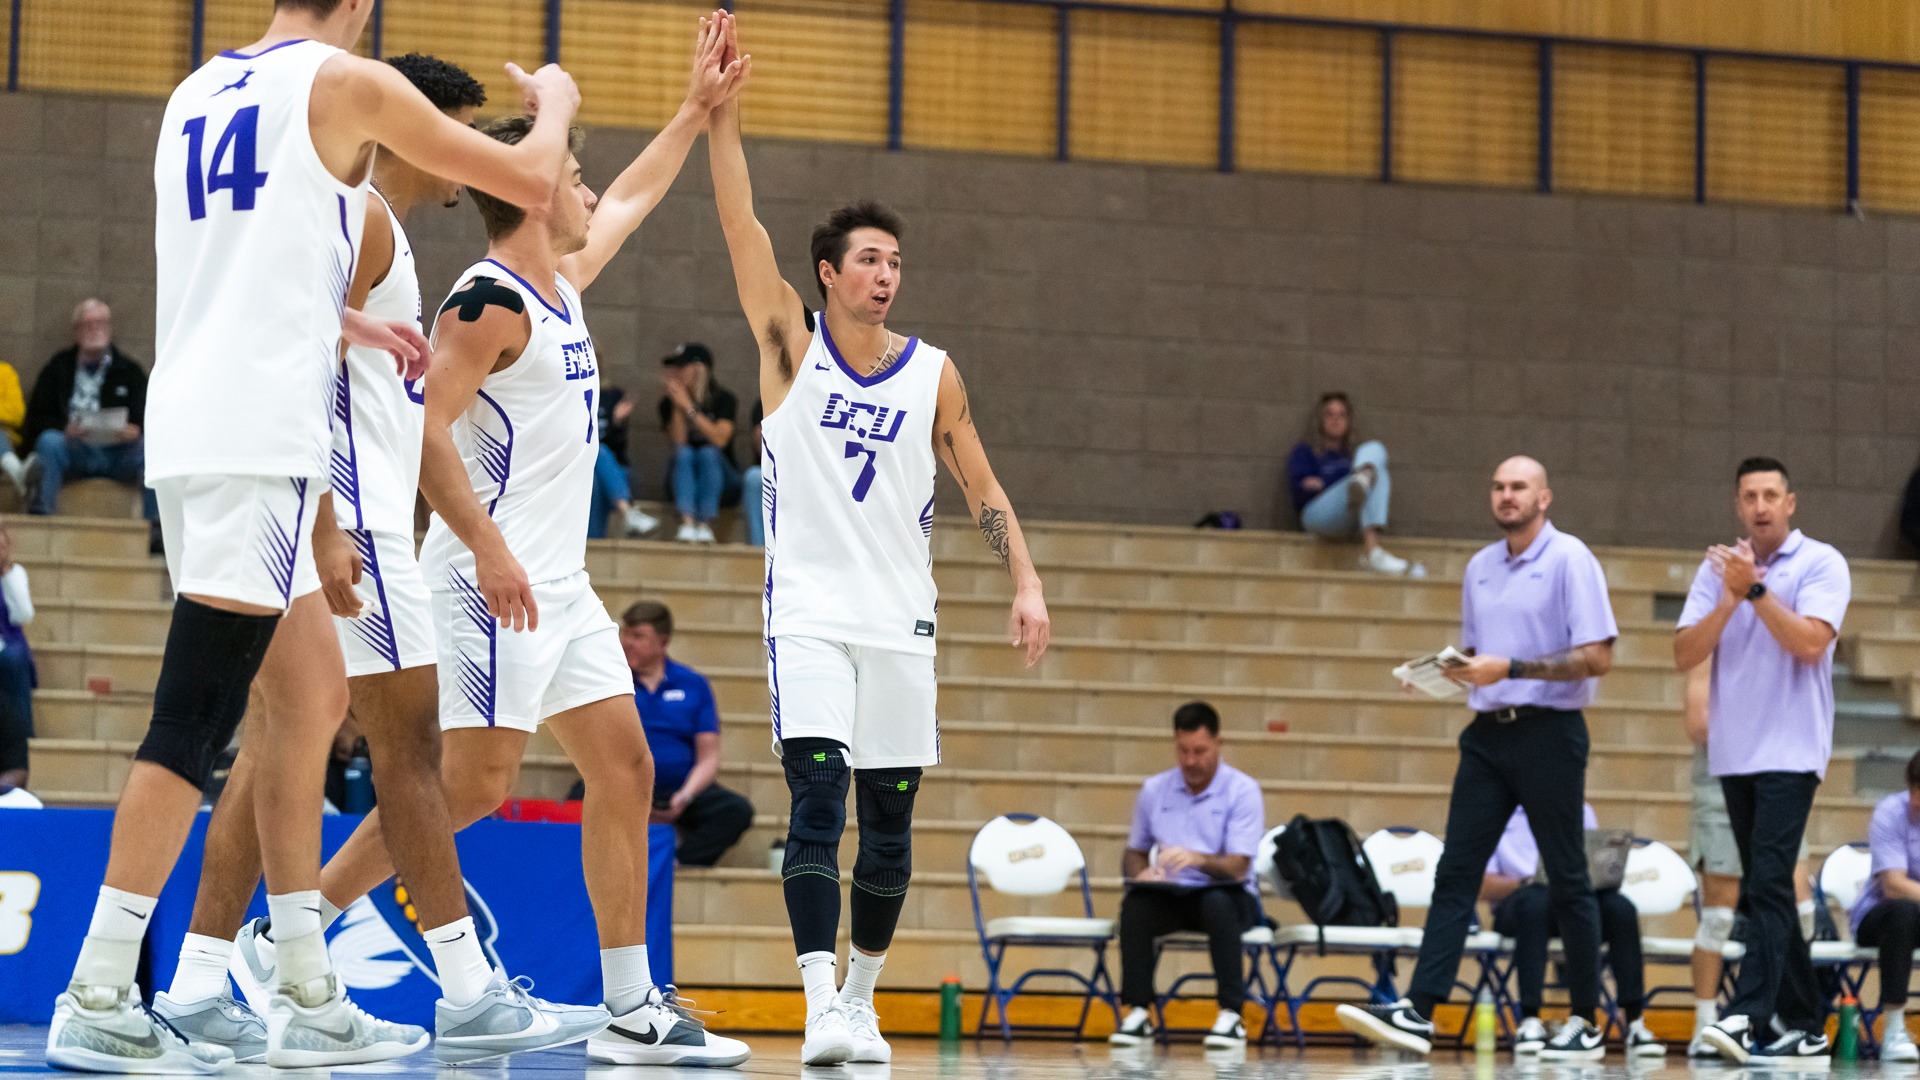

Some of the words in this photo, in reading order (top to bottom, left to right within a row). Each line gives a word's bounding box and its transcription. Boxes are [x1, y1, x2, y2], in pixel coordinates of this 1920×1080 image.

[181, 104, 269, 221] 14
[820, 392, 908, 443] GCU
[844, 440, 877, 503] 7
